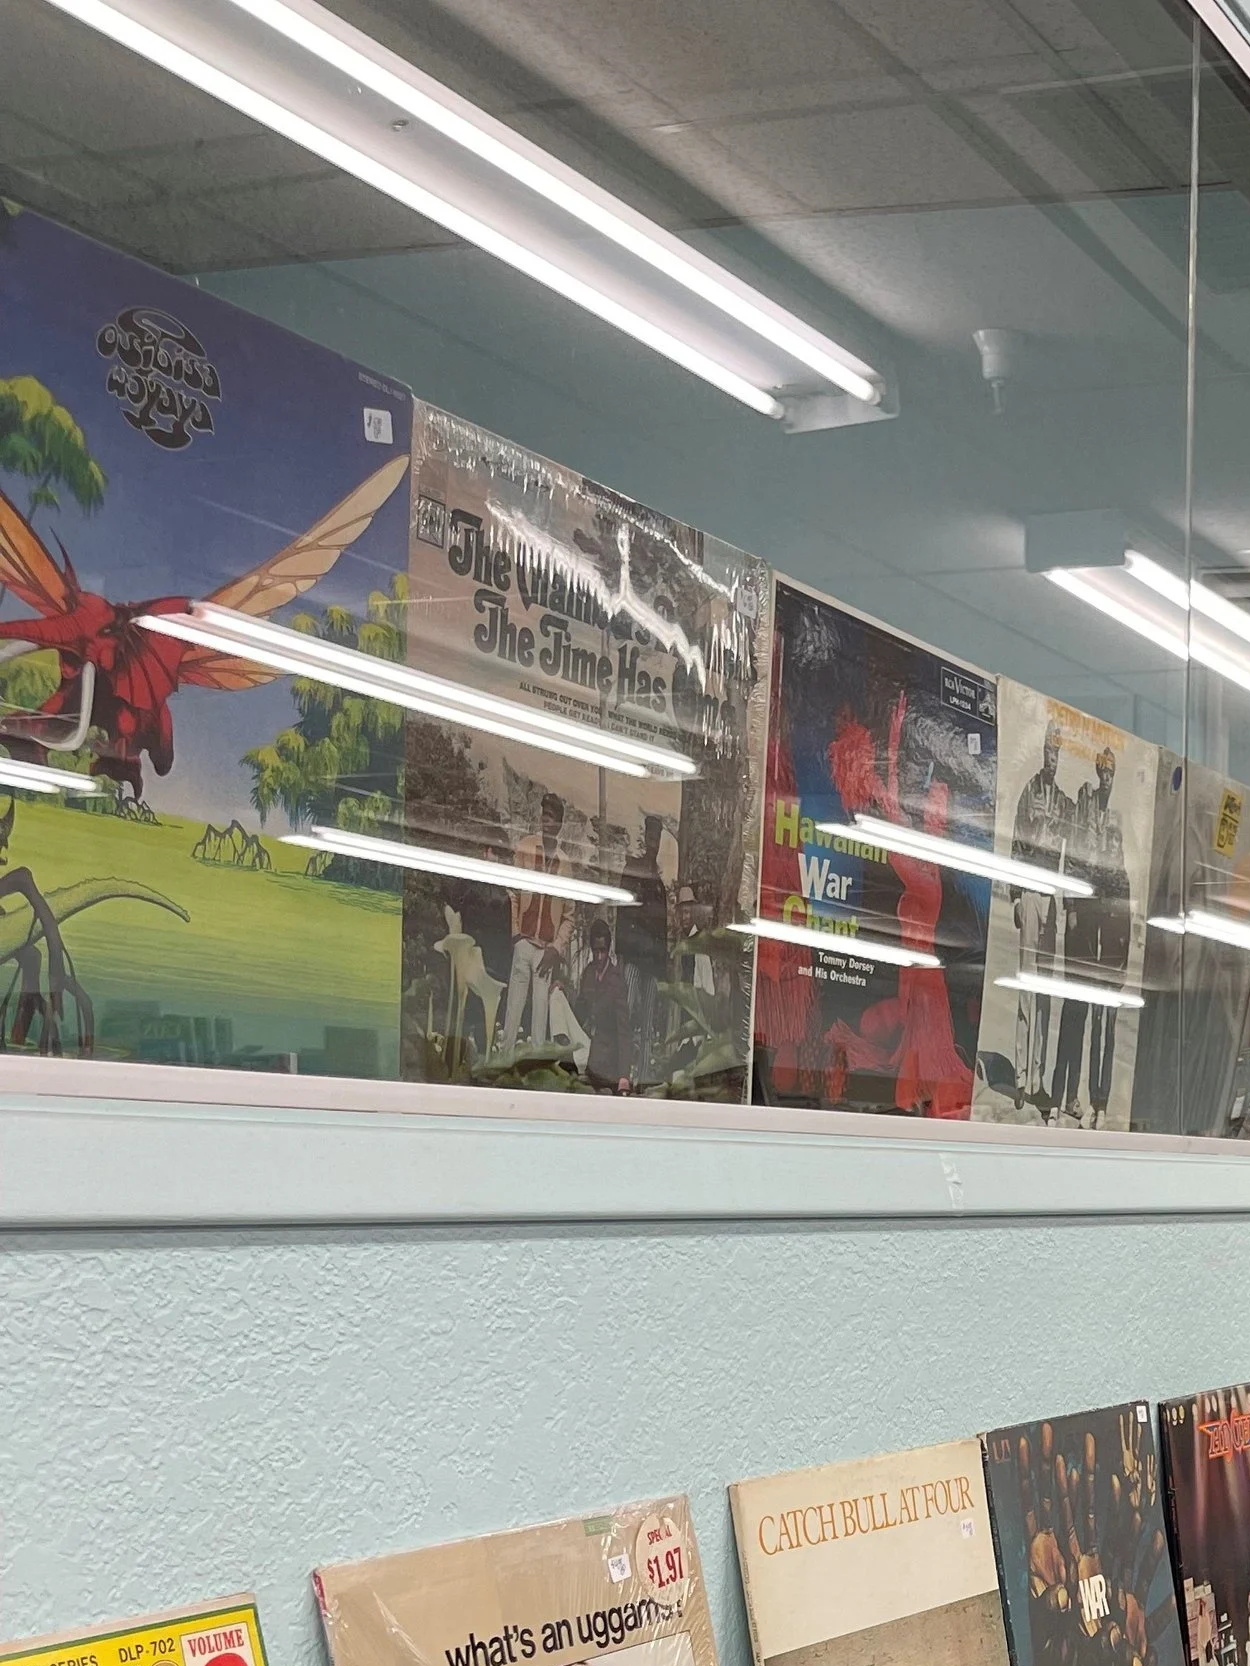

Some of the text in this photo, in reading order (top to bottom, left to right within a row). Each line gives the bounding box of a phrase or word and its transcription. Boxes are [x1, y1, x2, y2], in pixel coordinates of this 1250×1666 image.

[449, 508, 511, 590] The
[473, 588, 535, 668] The
[539, 613, 613, 695] Time
[613, 643, 667, 713] Has
[798, 853, 853, 901] War
[782, 895, 860, 938] Chant
[798, 965, 867, 987] and His Orchestra
[818, 952, 875, 974] Tommy Dorsey
[759, 1476, 975, 1556] CATCH BULL AT FOUR
[647, 1547, 684, 1588] $1.97
[1078, 1574, 1110, 1622] WAR
[118, 1637, 175, 1664] DLP-702
[188, 1628, 245, 1657] VOLUME
[541, 1619, 574, 1654] an
